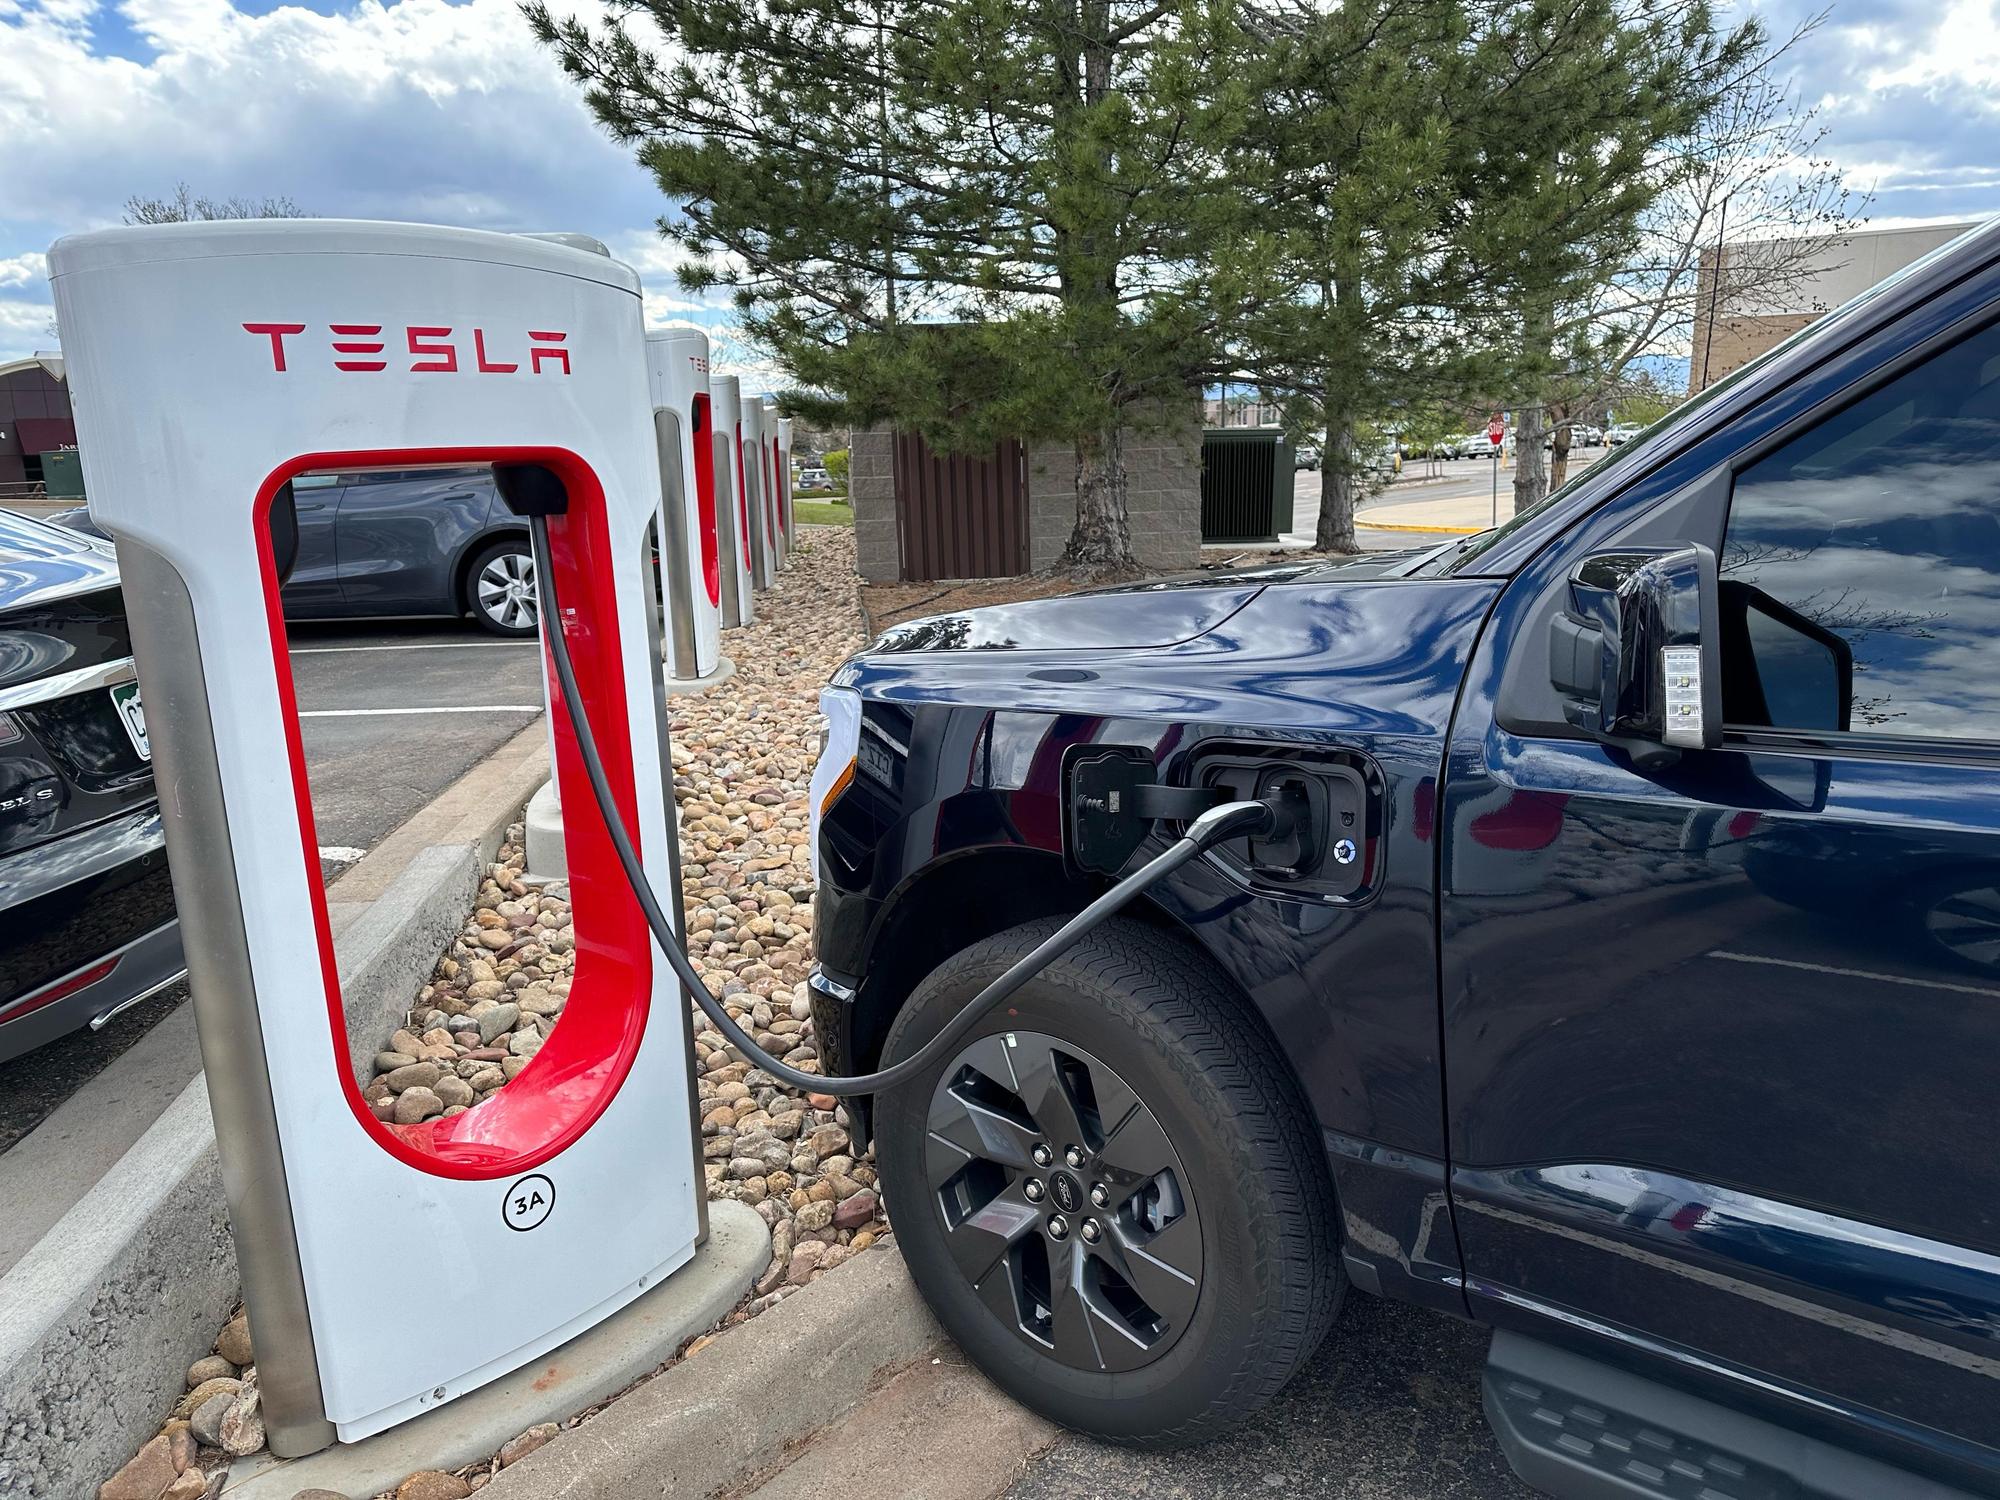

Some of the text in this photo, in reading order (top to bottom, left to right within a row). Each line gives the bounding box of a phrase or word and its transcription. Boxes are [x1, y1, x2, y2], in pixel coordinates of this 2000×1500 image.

[242, 322, 571, 375] TESLA
[36, 788, 54, 800] S
[514, 1190, 545, 1216] 3A
